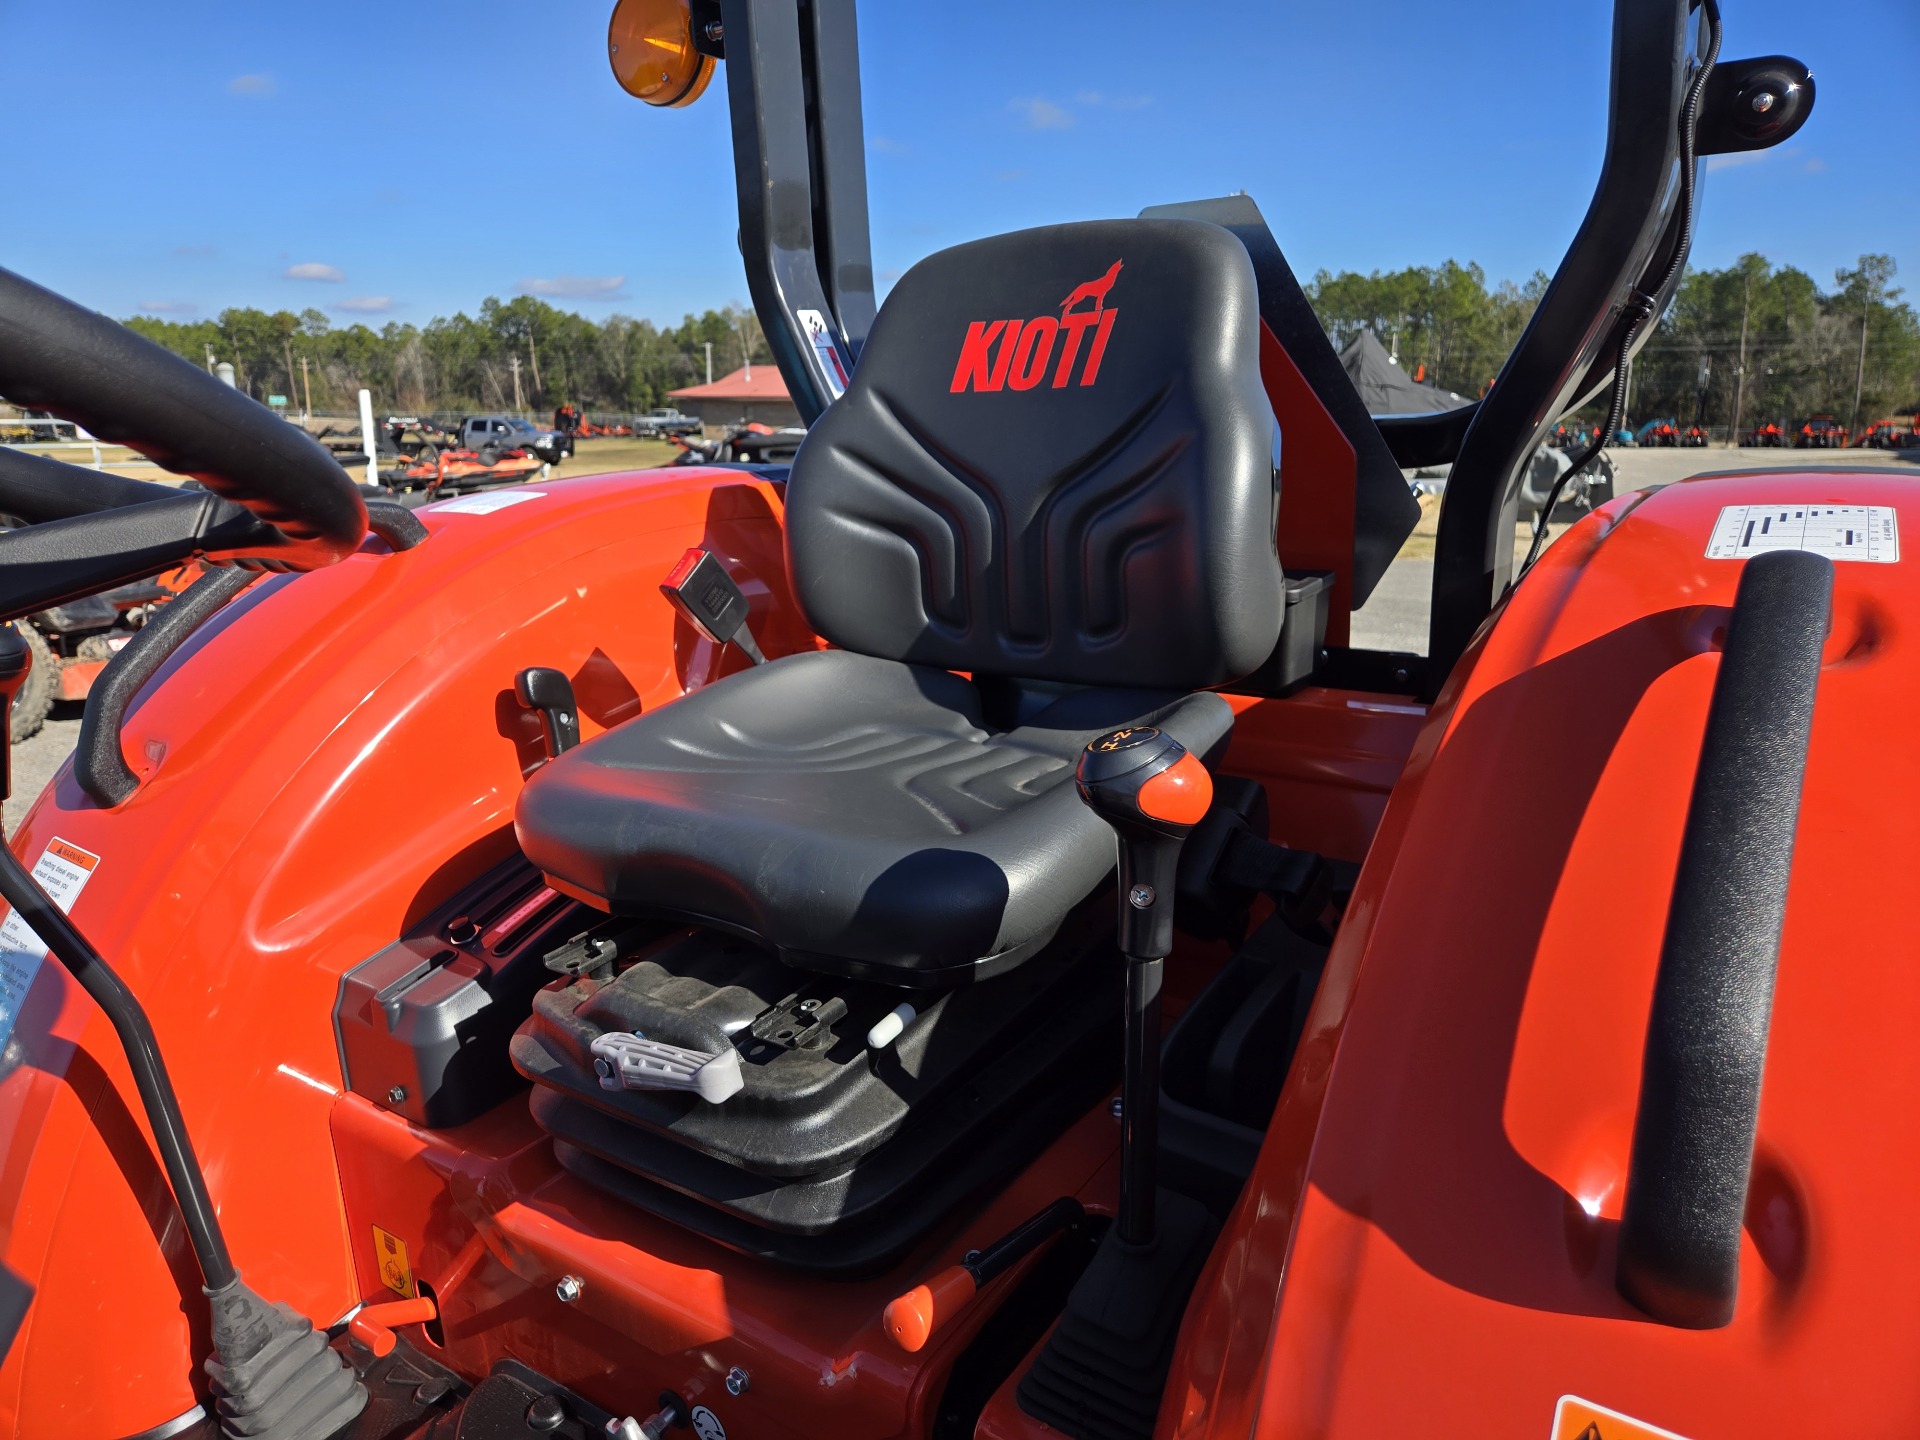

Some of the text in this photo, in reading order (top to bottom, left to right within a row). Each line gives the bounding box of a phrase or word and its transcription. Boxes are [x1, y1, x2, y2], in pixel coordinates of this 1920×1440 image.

[949, 308, 1119, 393] KIOTI
[62, 848, 85, 864] WARNING
[35, 869, 47, 879] exhaust
[47, 875, 61, 886] exposes
[60, 882, 69, 890] you
[41, 858, 79, 882] Breathing diesel engine
